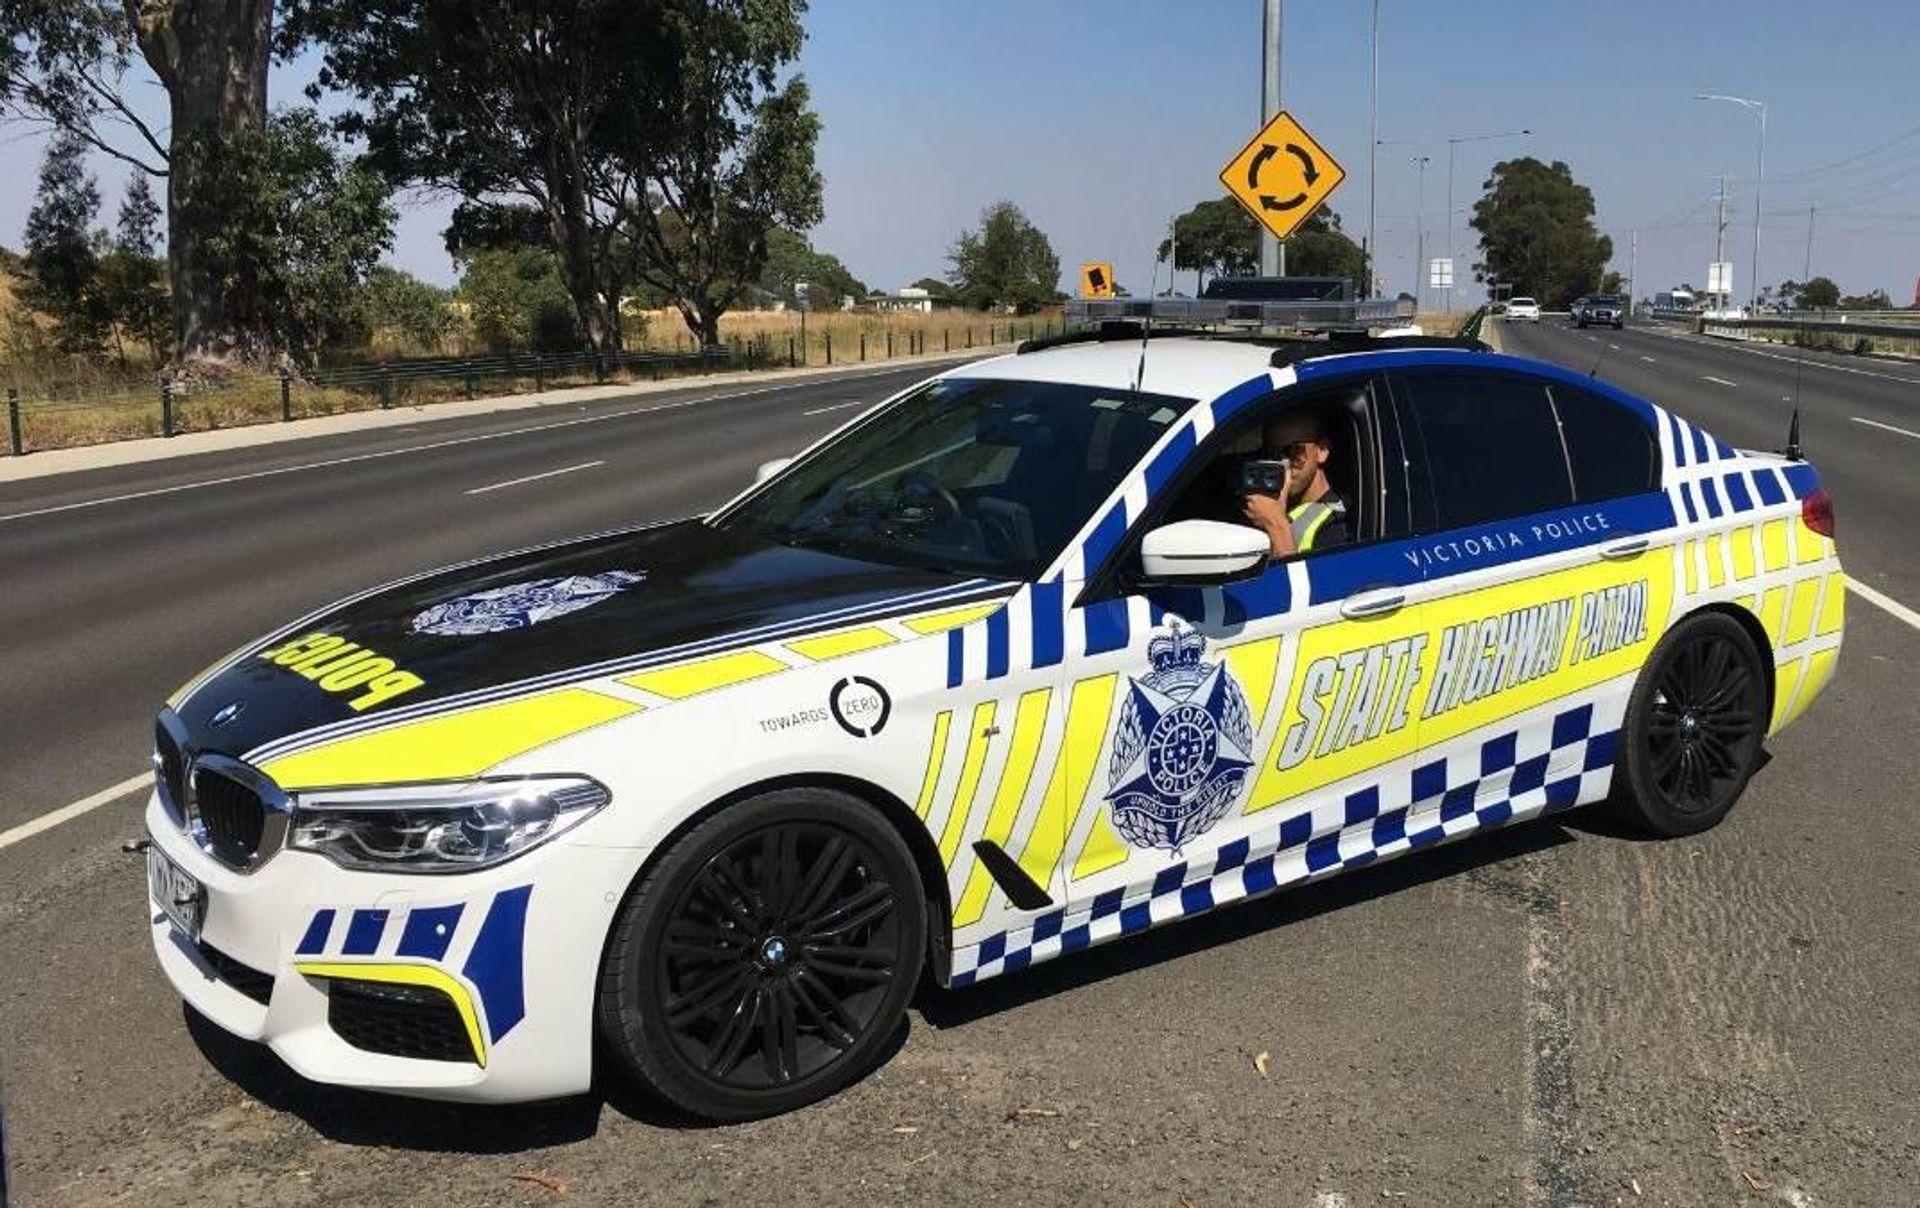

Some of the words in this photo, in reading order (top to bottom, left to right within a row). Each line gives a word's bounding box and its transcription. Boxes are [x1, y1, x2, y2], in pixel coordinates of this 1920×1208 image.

[1404, 531, 1524, 568] VICTORIA
[1531, 513, 1610, 541] POLICE
[1276, 633, 1429, 772] STATE
[1420, 597, 1575, 721] HIGHWAY
[1569, 579, 1649, 667] PATROL
[759, 707, 830, 733] TOWARDS
[843, 694, 880, 716] ZERO
[1150, 707, 1215, 749] VICTORIA
[1155, 760, 1211, 792] POLICE
